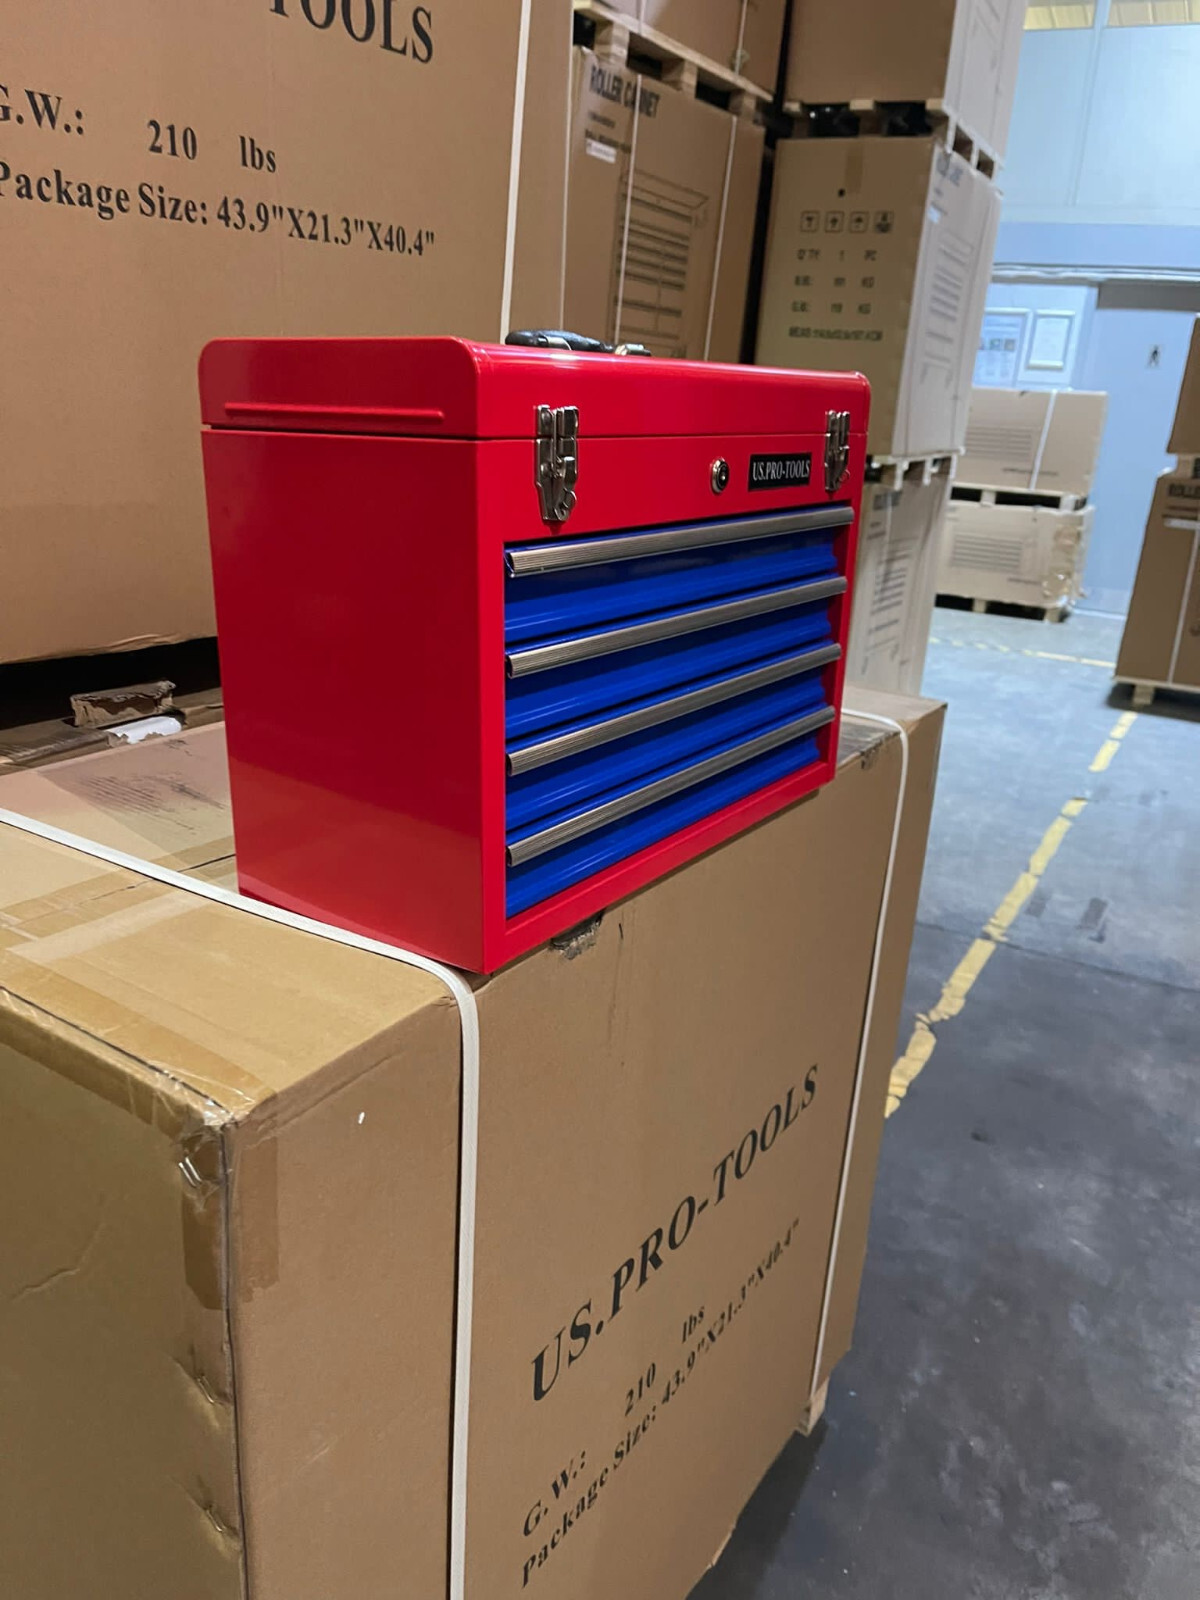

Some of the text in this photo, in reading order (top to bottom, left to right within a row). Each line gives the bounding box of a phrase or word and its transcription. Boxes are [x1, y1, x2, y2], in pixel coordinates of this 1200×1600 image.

[147, 119, 198, 161] 210
[239, 134, 277, 174] lbs
[138, 182, 208, 226] Size:
[217, 196, 435, 257] 43.9"X21.3"X40.4"
[752, 459, 811, 481] US.PRO-TOOLS
[531, 1064, 819, 1402] US.PRO-TOOLS
[624, 1306, 705, 1418] 210 lbs
[522, 1467, 609, 1590] Package
[613, 1405, 657, 1471] Size:
